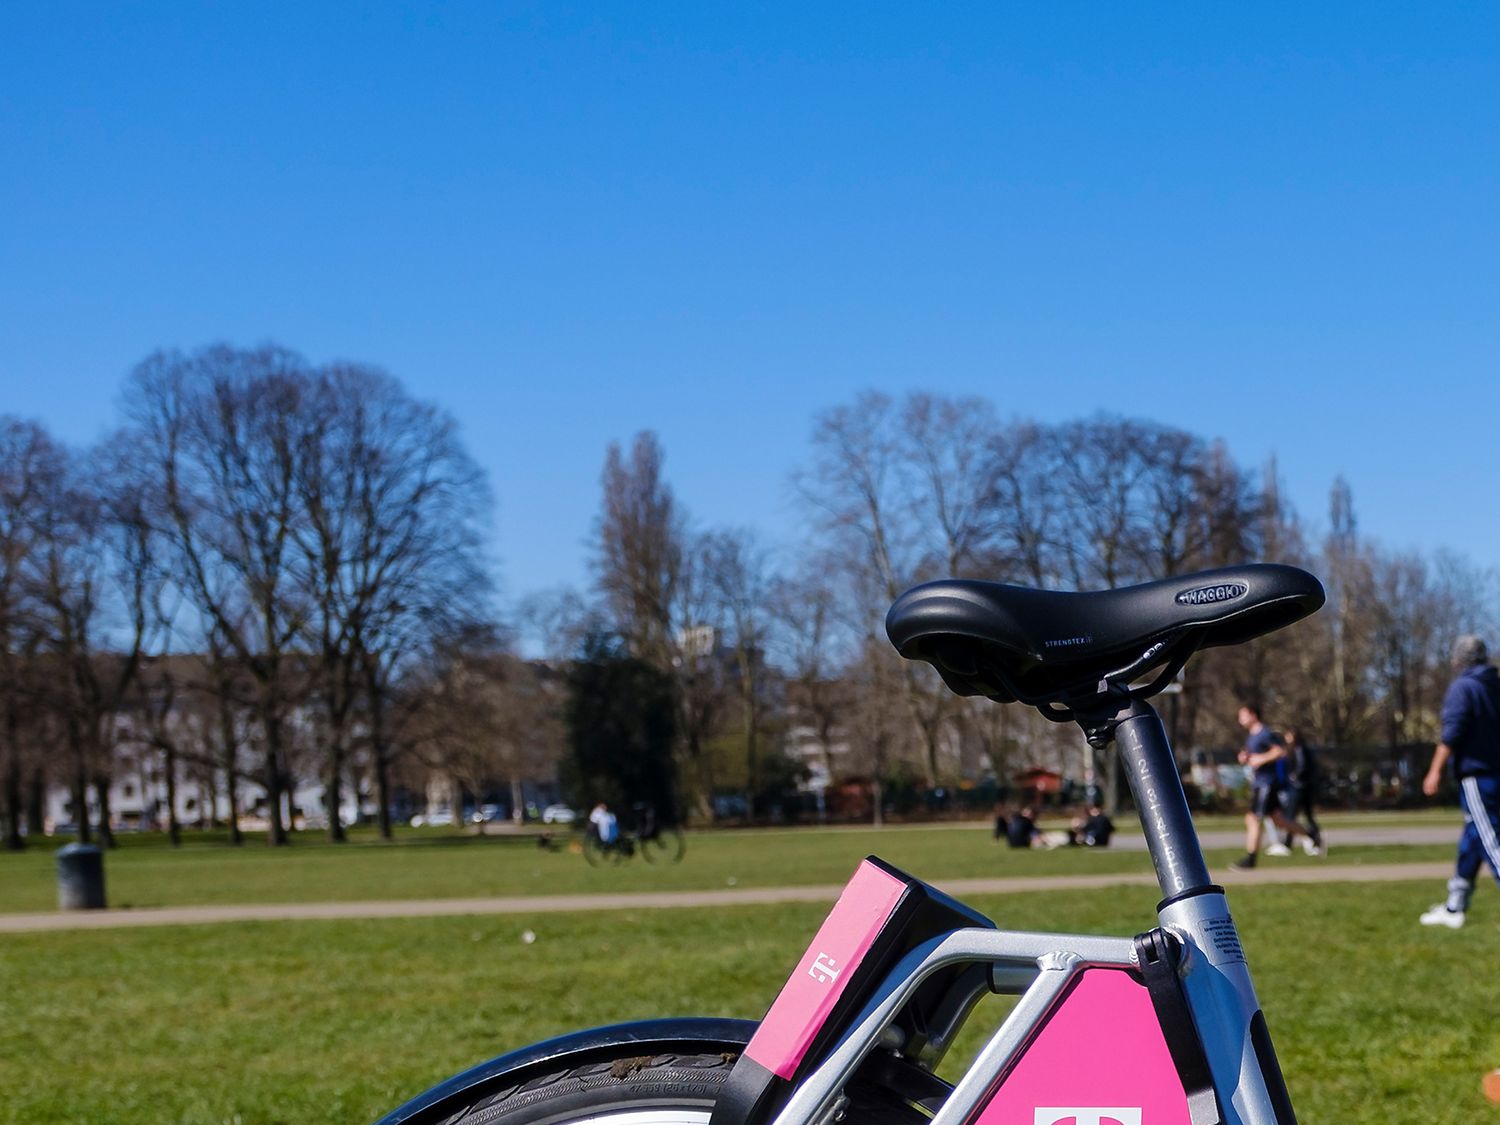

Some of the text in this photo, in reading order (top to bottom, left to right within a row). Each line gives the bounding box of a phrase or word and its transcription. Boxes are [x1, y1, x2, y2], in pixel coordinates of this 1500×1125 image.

[1129, 728, 1139, 743] 1
[1138, 759, 1148, 774] 2
[1156, 817, 1167, 832] 4
[1174, 876, 1185, 891] 6
[808, 952, 840, 984] T
